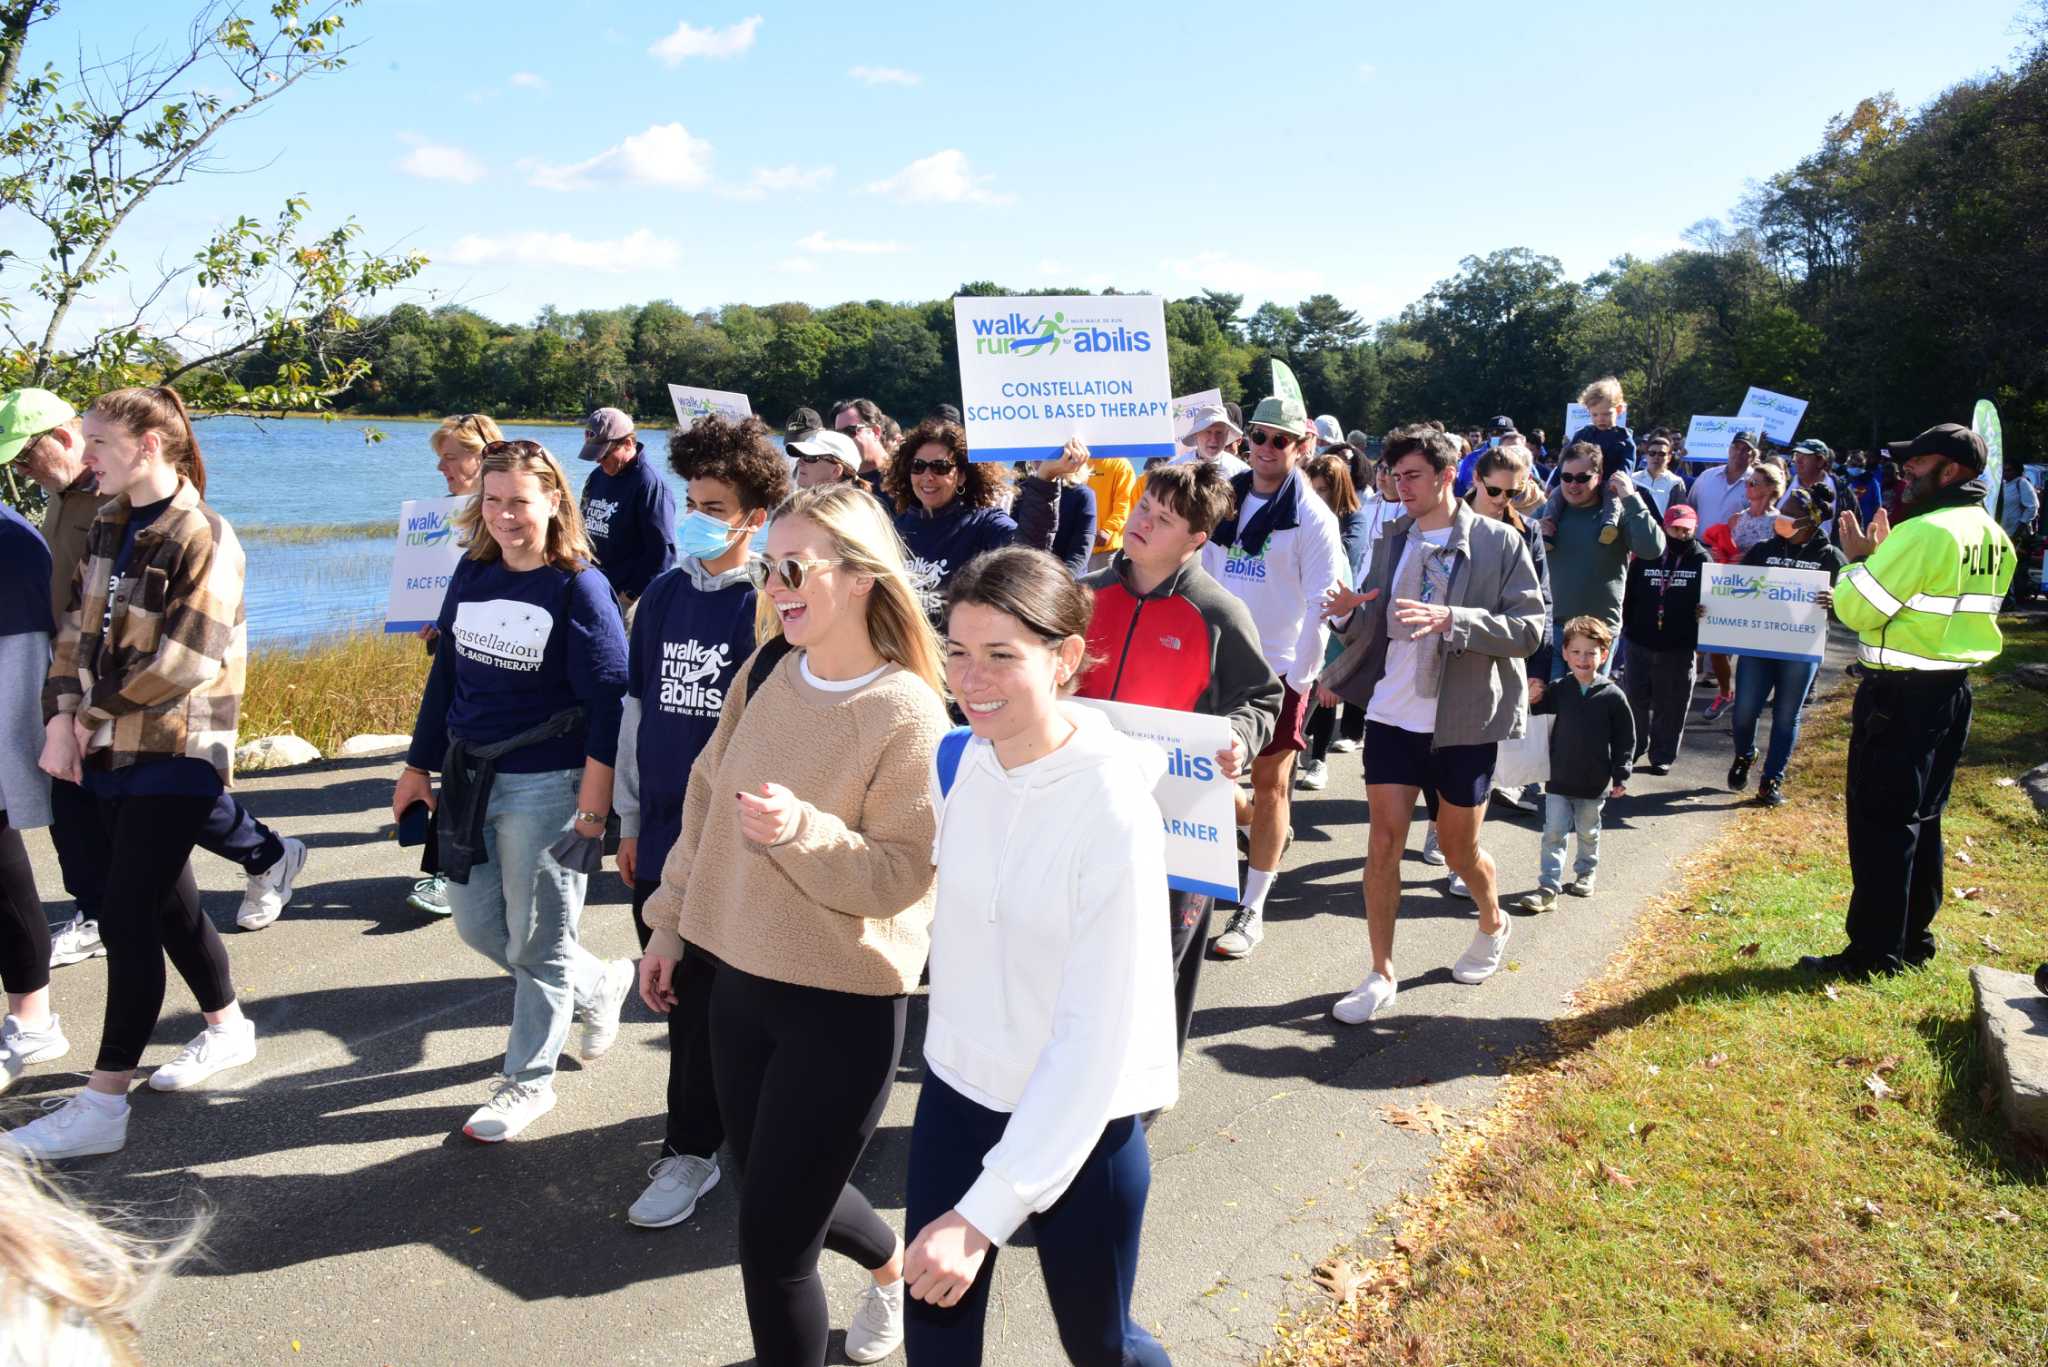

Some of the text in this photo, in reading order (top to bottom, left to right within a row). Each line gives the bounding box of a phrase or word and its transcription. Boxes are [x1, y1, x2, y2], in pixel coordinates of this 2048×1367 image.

[972, 313, 1033, 335] walk
[976, 337, 1019, 355] run
[1074, 327, 1151, 352] abilis
[1001, 381, 1133, 398] CONSTELLATION
[967, 405, 1039, 421] SCHOOL
[1044, 403, 1096, 419] BASED
[1100, 402, 1168, 417] THERAPY
[408, 512, 439, 531] walk
[407, 577, 433, 590] RACE
[1711, 574, 1746, 587] walk
[1768, 586, 1818, 604] abilis
[1706, 615, 1817, 634] SUMMER ST STROLLERS
[663, 639, 707, 663] walk
[494, 658, 541, 672] THERAPY
[661, 660, 690, 678] run
[660, 680, 722, 710] abilis
[677, 707, 693, 715] WALK
[1168, 748, 1214, 782] ilis
